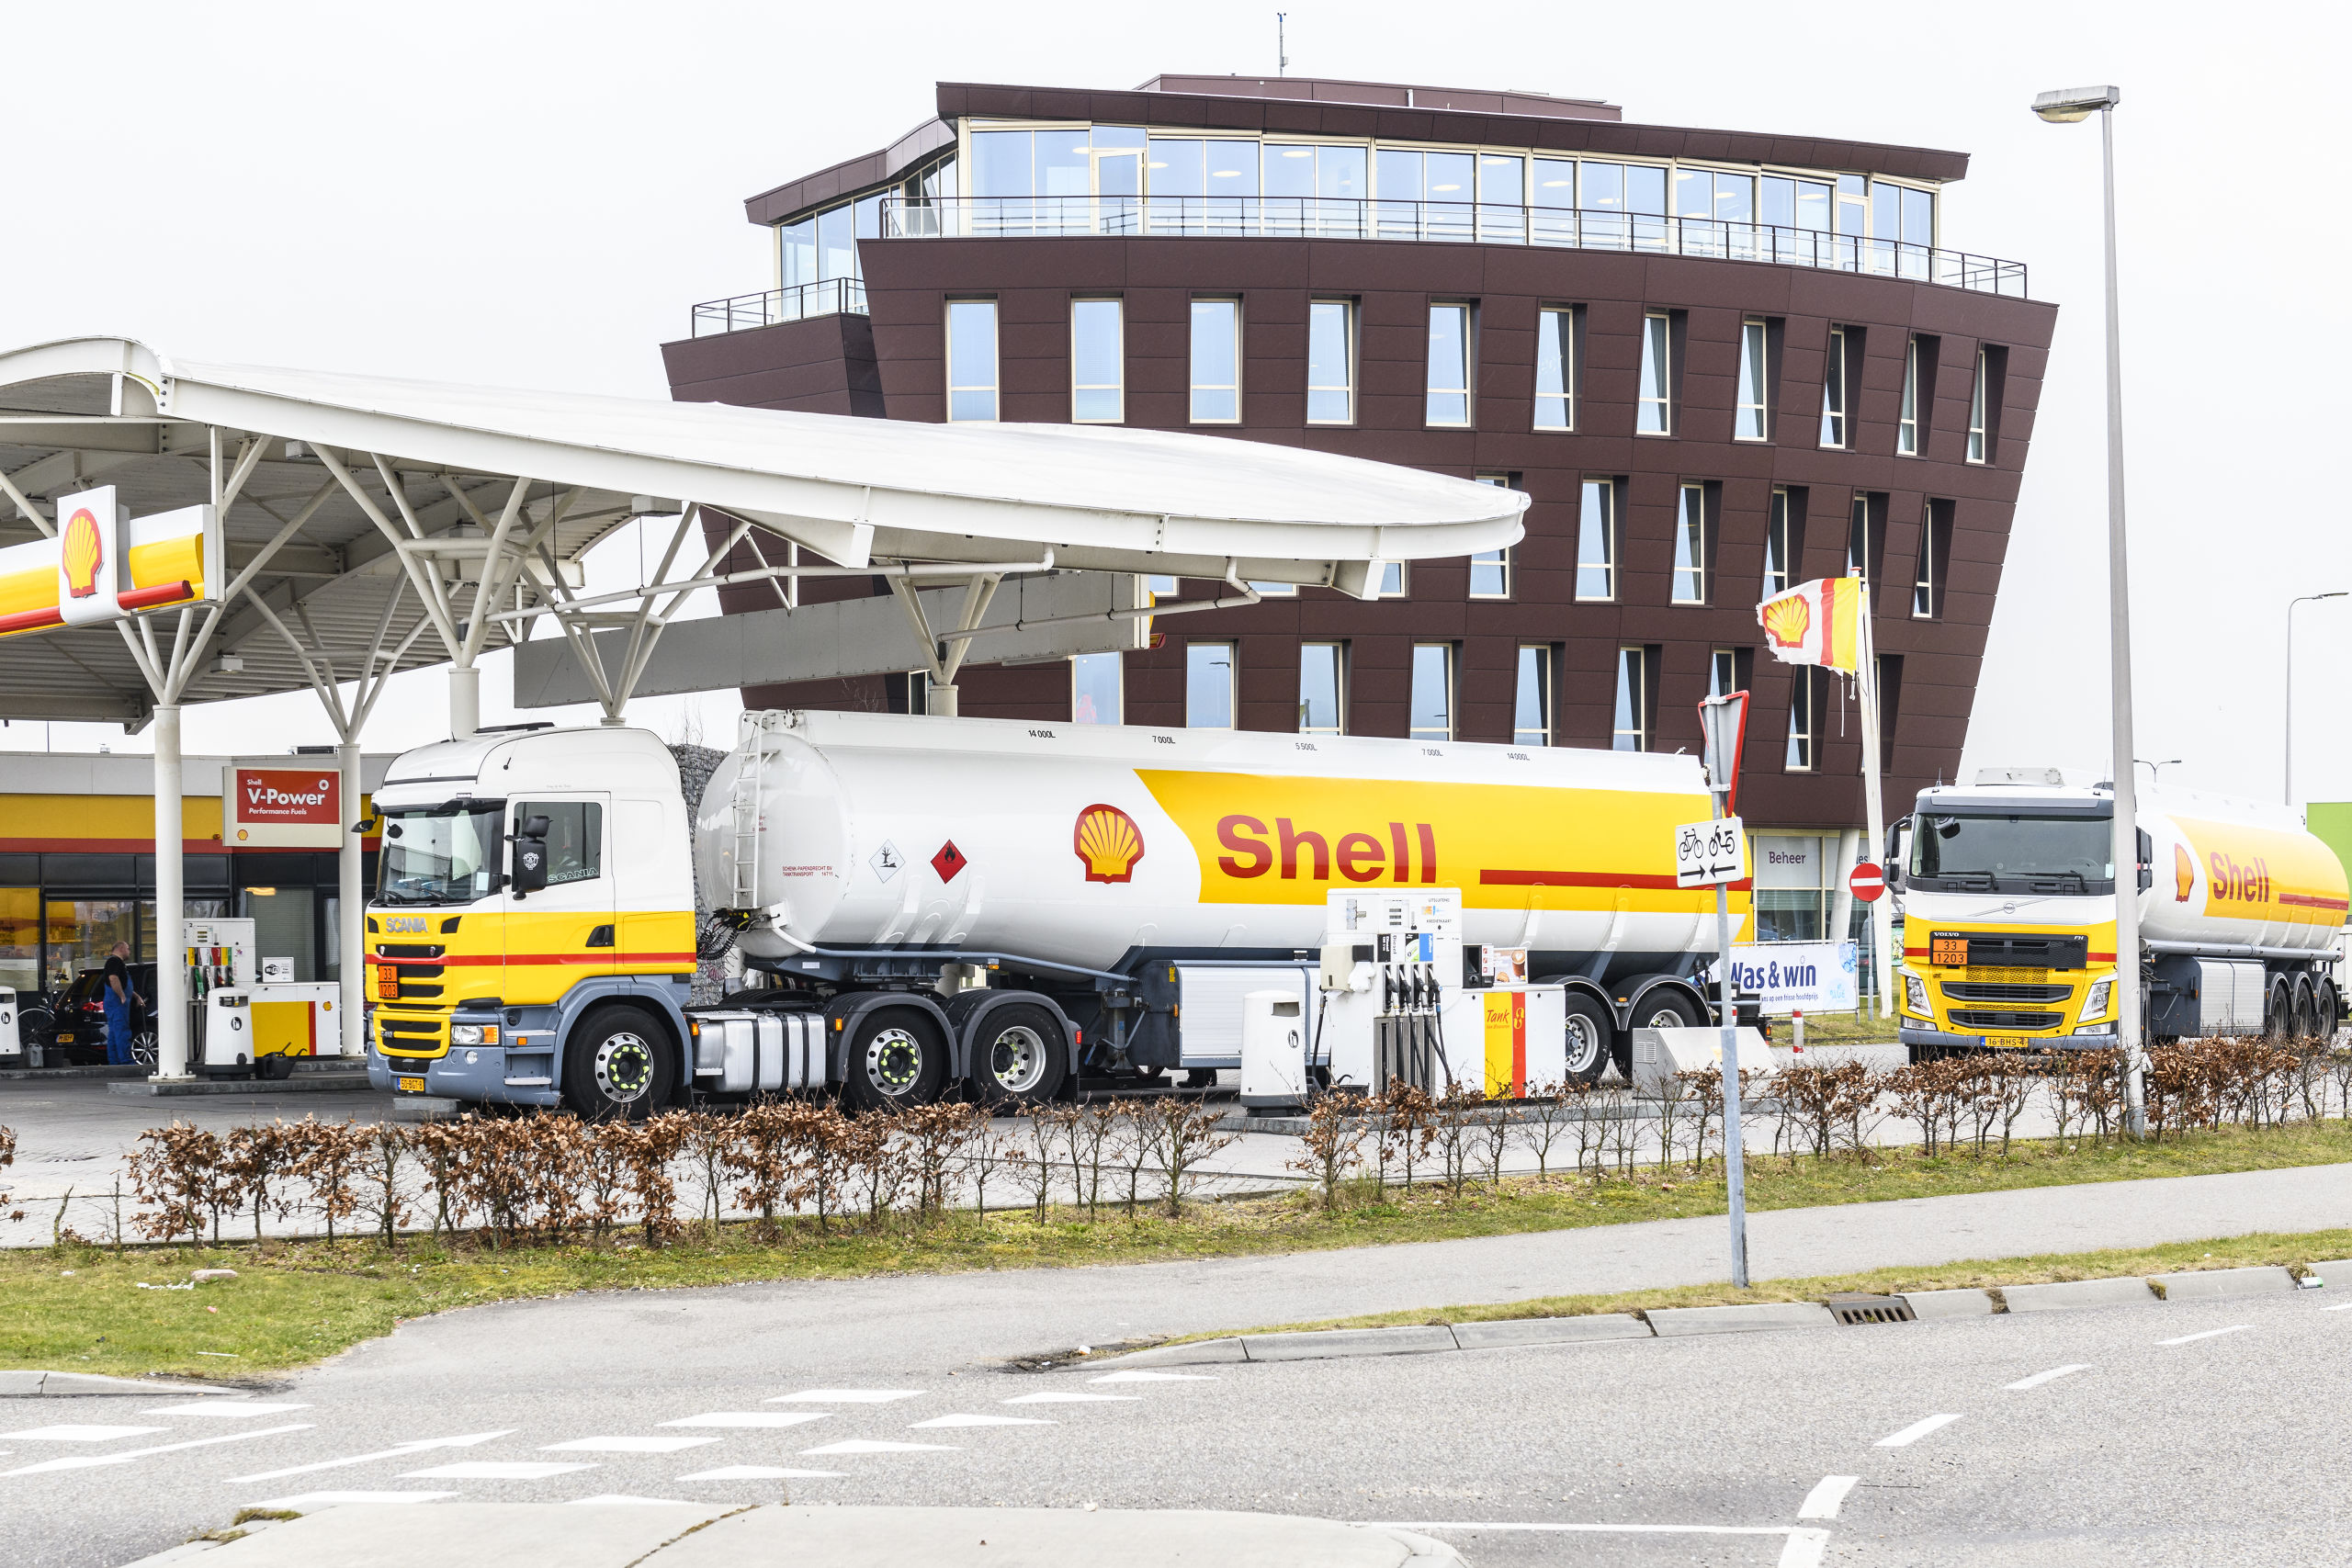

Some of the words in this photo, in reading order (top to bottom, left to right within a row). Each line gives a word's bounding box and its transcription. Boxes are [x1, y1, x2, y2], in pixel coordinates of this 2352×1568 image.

[1037, 730, 1056, 739] 000L
[1158, 736, 1176, 744] 000L
[247, 788, 325, 806] V-Power
[1216, 814, 1436, 884] Shell
[1769, 852, 1806, 864] Beheer
[547, 867, 599, 883] SCANIA
[2210, 852, 2269, 903] Shell
[386, 918, 428, 932] SCANIA
[1943, 941, 1957, 951] 33
[1937, 953, 1964, 964] 1203
[383, 967, 392, 980] 33
[1768, 961, 1781, 989] &
[1783, 955, 1816, 987] win
[380, 984, 396, 997] 1203
[1795, 993, 1819, 1001] hoofdprijs
[1487, 1009, 1510, 1024] Tank
[1988, 1038, 2025, 1046] 16-BHS-4
